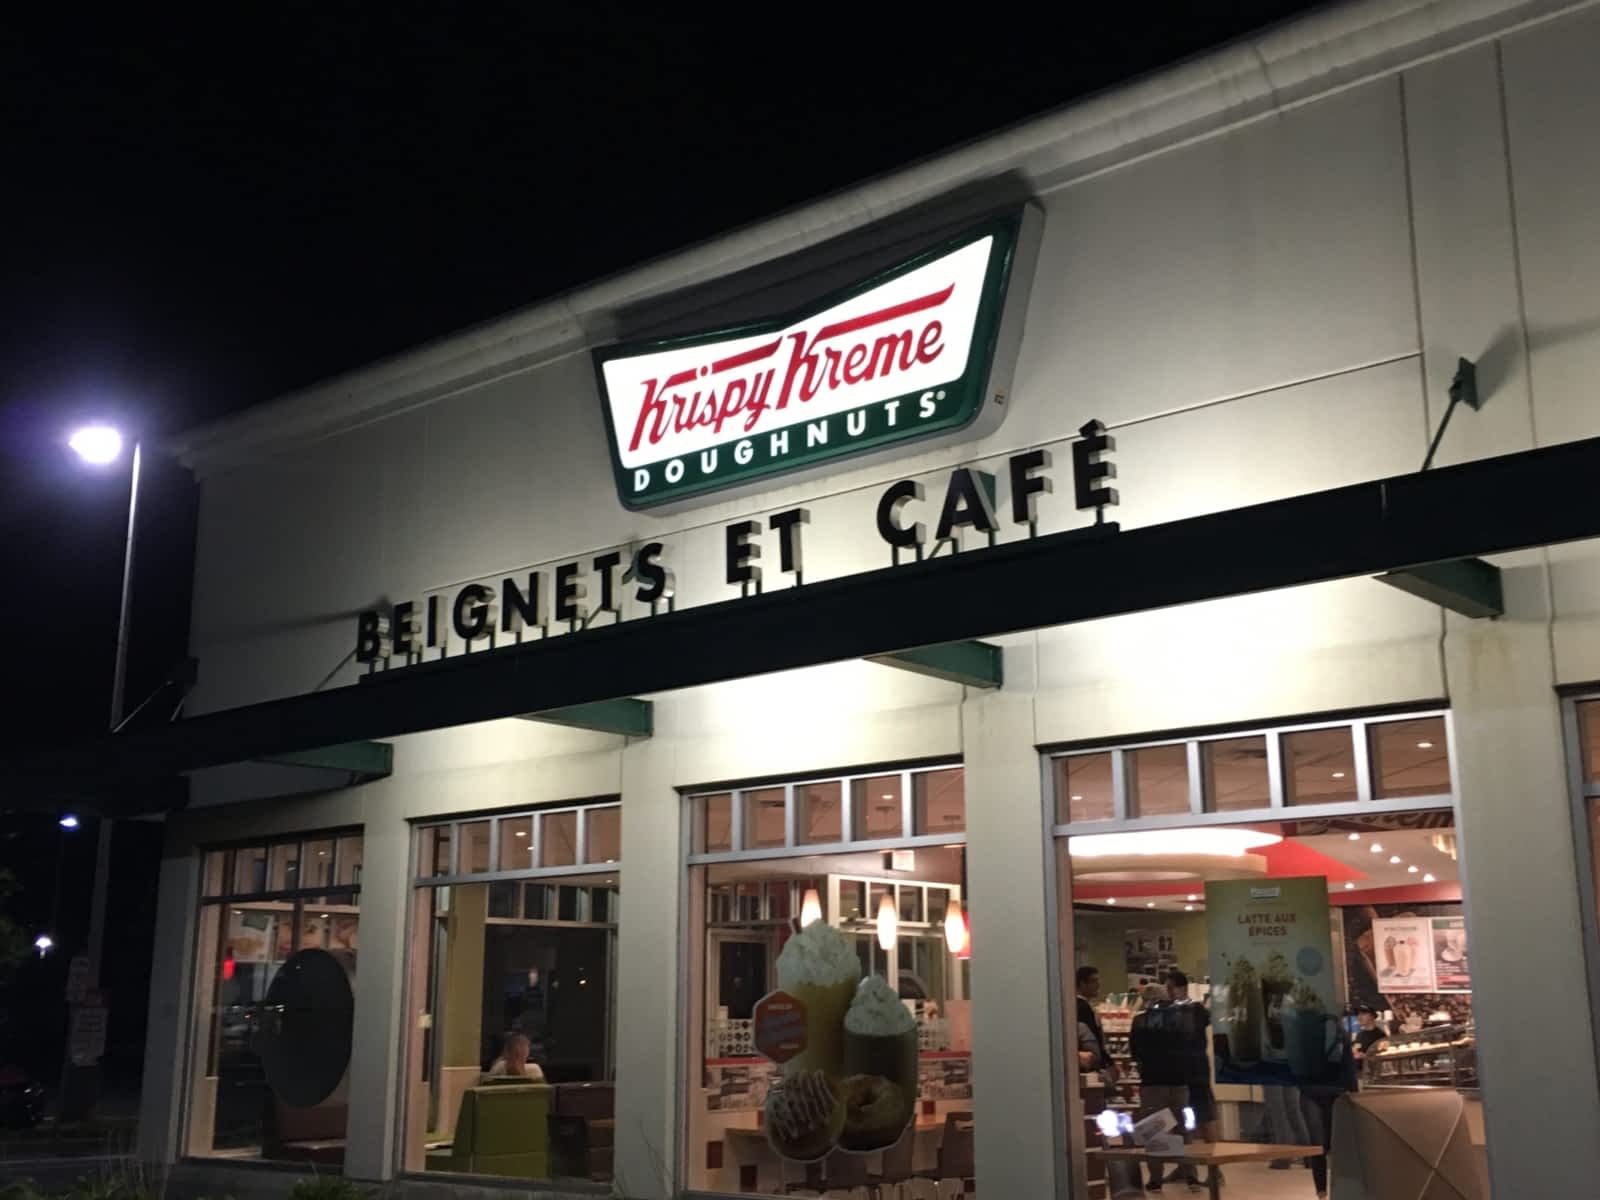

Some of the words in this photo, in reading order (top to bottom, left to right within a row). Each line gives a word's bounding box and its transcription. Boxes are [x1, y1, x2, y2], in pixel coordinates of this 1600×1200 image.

[628, 336, 784, 452] Krispy
[776, 282, 956, 410] Kreme
[633, 390, 937, 493] DOUGHNUTS
[356, 542, 672, 664] BEIGNETS
[726, 507, 809, 585] ET
[876, 419, 1119, 551] CAFÉ
[1237, 912, 1272, 924] LATTE
[1274, 911, 1297, 924] AUX
